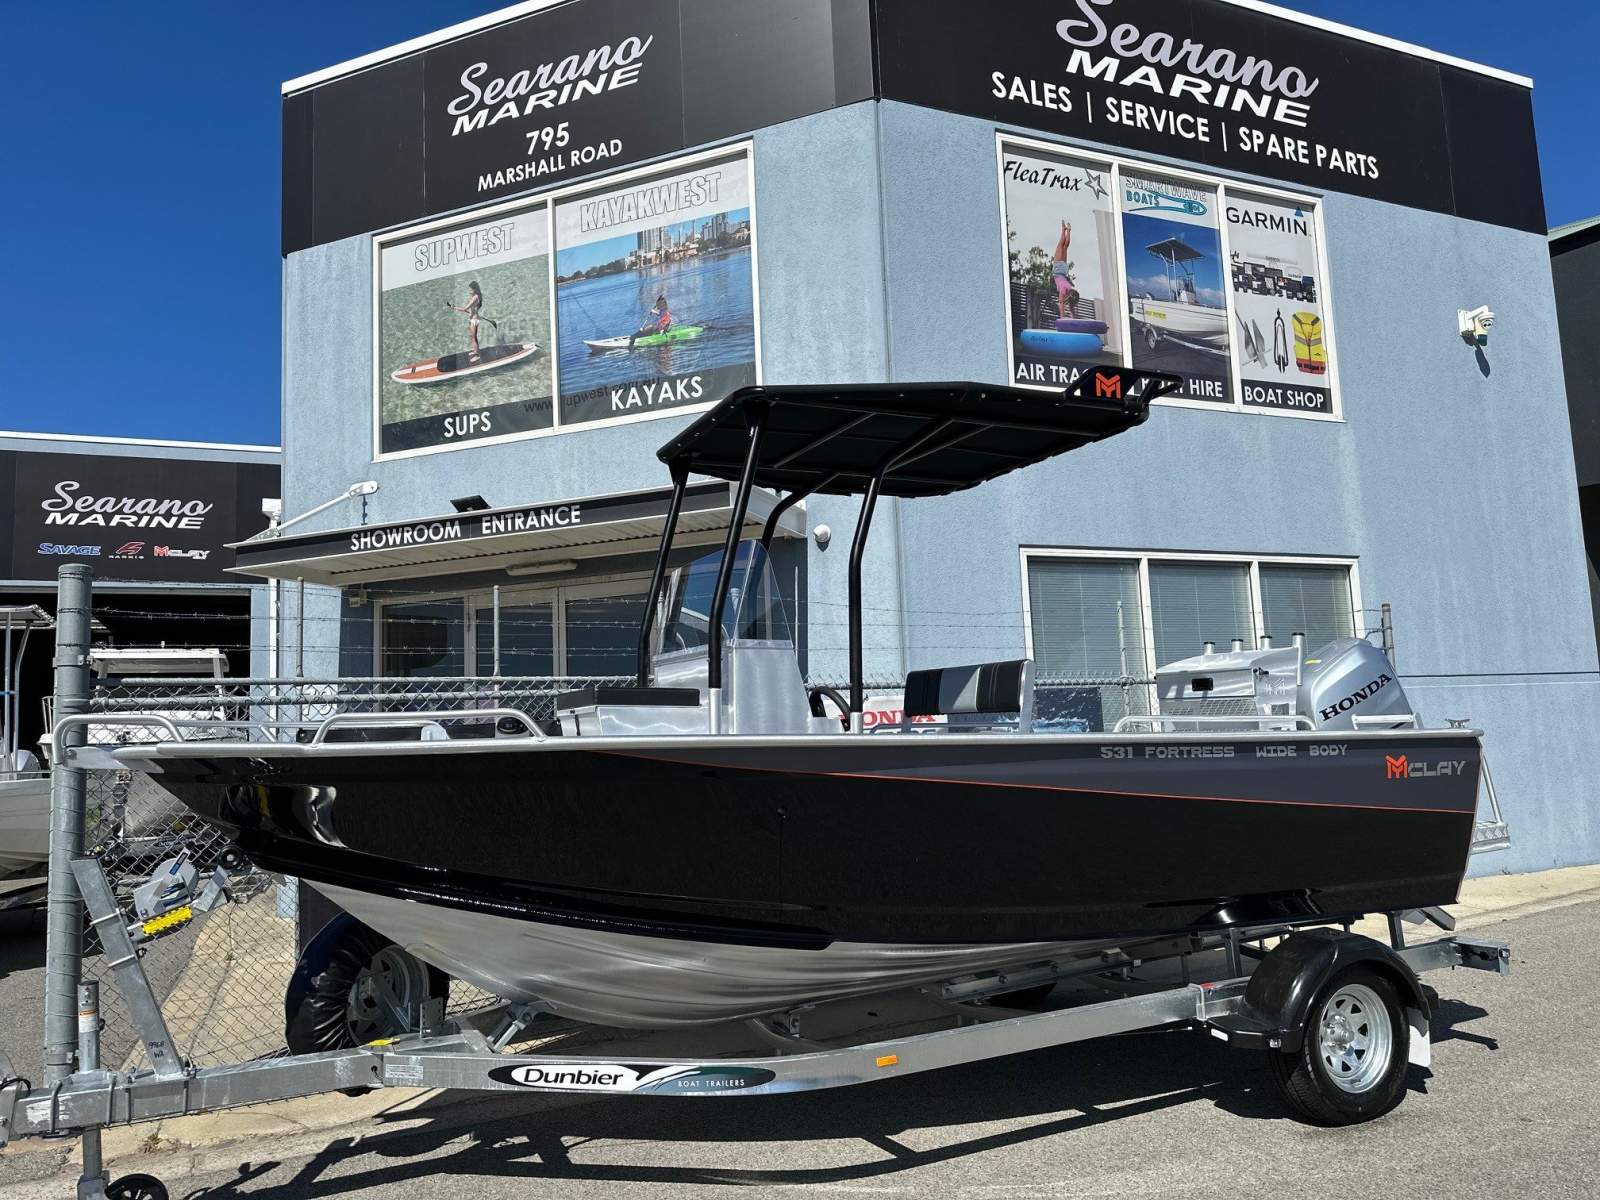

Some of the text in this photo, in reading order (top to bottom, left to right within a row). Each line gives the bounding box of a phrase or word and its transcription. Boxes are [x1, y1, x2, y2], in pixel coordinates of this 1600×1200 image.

[1055, 0, 1319, 99] Searano
[447, 34, 654, 116] Searano
[1065, 49, 1311, 128] MARINE
[452, 62, 643, 136] MARINE
[525, 122, 570, 155] 795
[991, 71, 1379, 180] SALES SERVICE SPARE PARTS
[477, 139, 623, 192] MARSHALL ROAD
[1003, 160, 1083, 192] FleaTrax
[580, 171, 722, 233] KAYAKWEST
[1126, 189, 1160, 208] BOATS
[1225, 206, 1308, 237] GARMIN
[414, 222, 514, 272] SUPWEST
[1016, 362, 1045, 382] AIR
[1189, 378, 1223, 398] HIRE
[611, 375, 703, 411] KAYAKS
[1243, 385, 1325, 409] BOAT SHOP
[443, 411, 492, 438] SUPS
[41, 480, 213, 517] Searano
[44, 512, 205, 529] MARINE
[350, 505, 581, 551] SHOWROOM ENTRANCE
[37, 543, 101, 556] SAVAGE
[1318, 673, 1393, 722] HONDA
[1100, 743, 1348, 760] 531 FORTRESS WIDE BODY
[523, 1067, 623, 1086] Dunbier
[677, 1079, 745, 1088] BOAT TRAILERS
